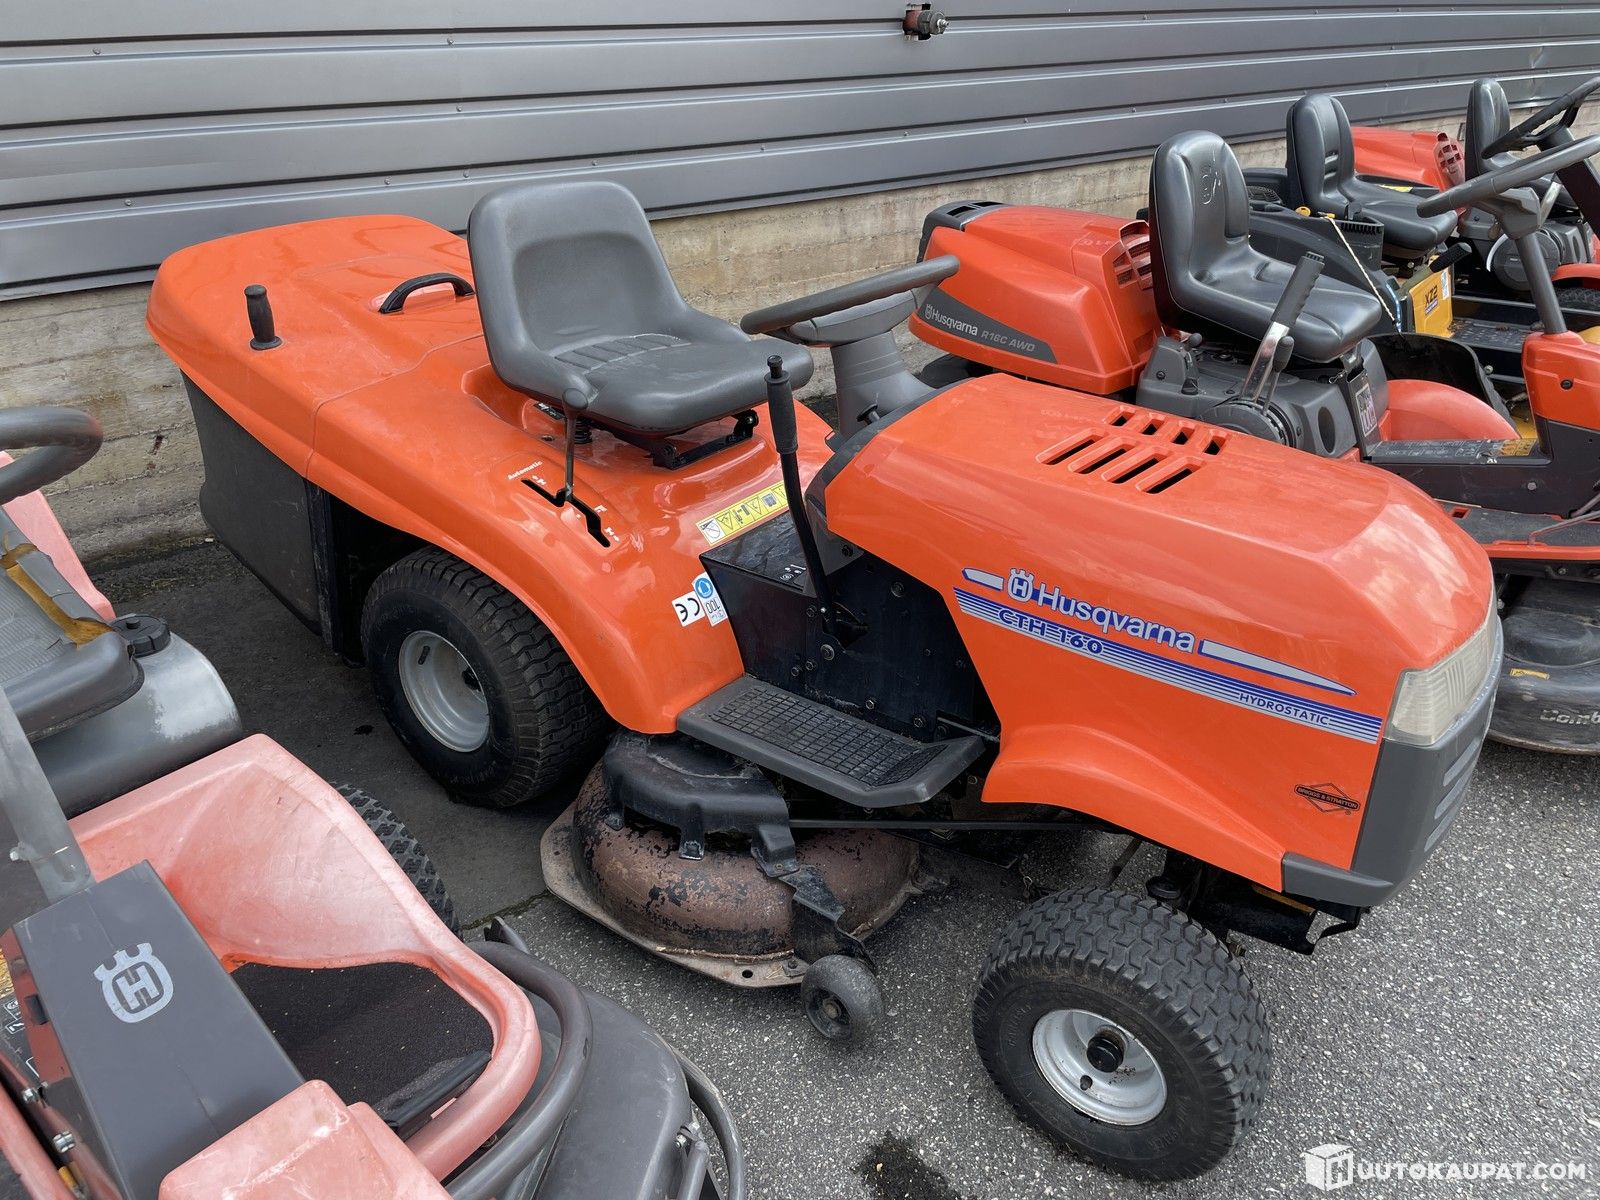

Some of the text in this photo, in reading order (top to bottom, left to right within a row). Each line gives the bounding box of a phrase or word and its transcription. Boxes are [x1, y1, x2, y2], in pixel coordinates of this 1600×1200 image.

[931, 308, 978, 336] Husqvarna
[1008, 338, 1036, 352] AWD
[506, 460, 543, 480] Automatic
[675, 597, 700, 623] CE
[1037, 582, 1196, 654] Husqvarna
[998, 608, 1103, 655] CTH 160
[1238, 692, 1331, 726] HYDROSTATIC
[1297, 787, 1321, 799] BRIGGS
[1326, 795, 1358, 809] STRATTON
